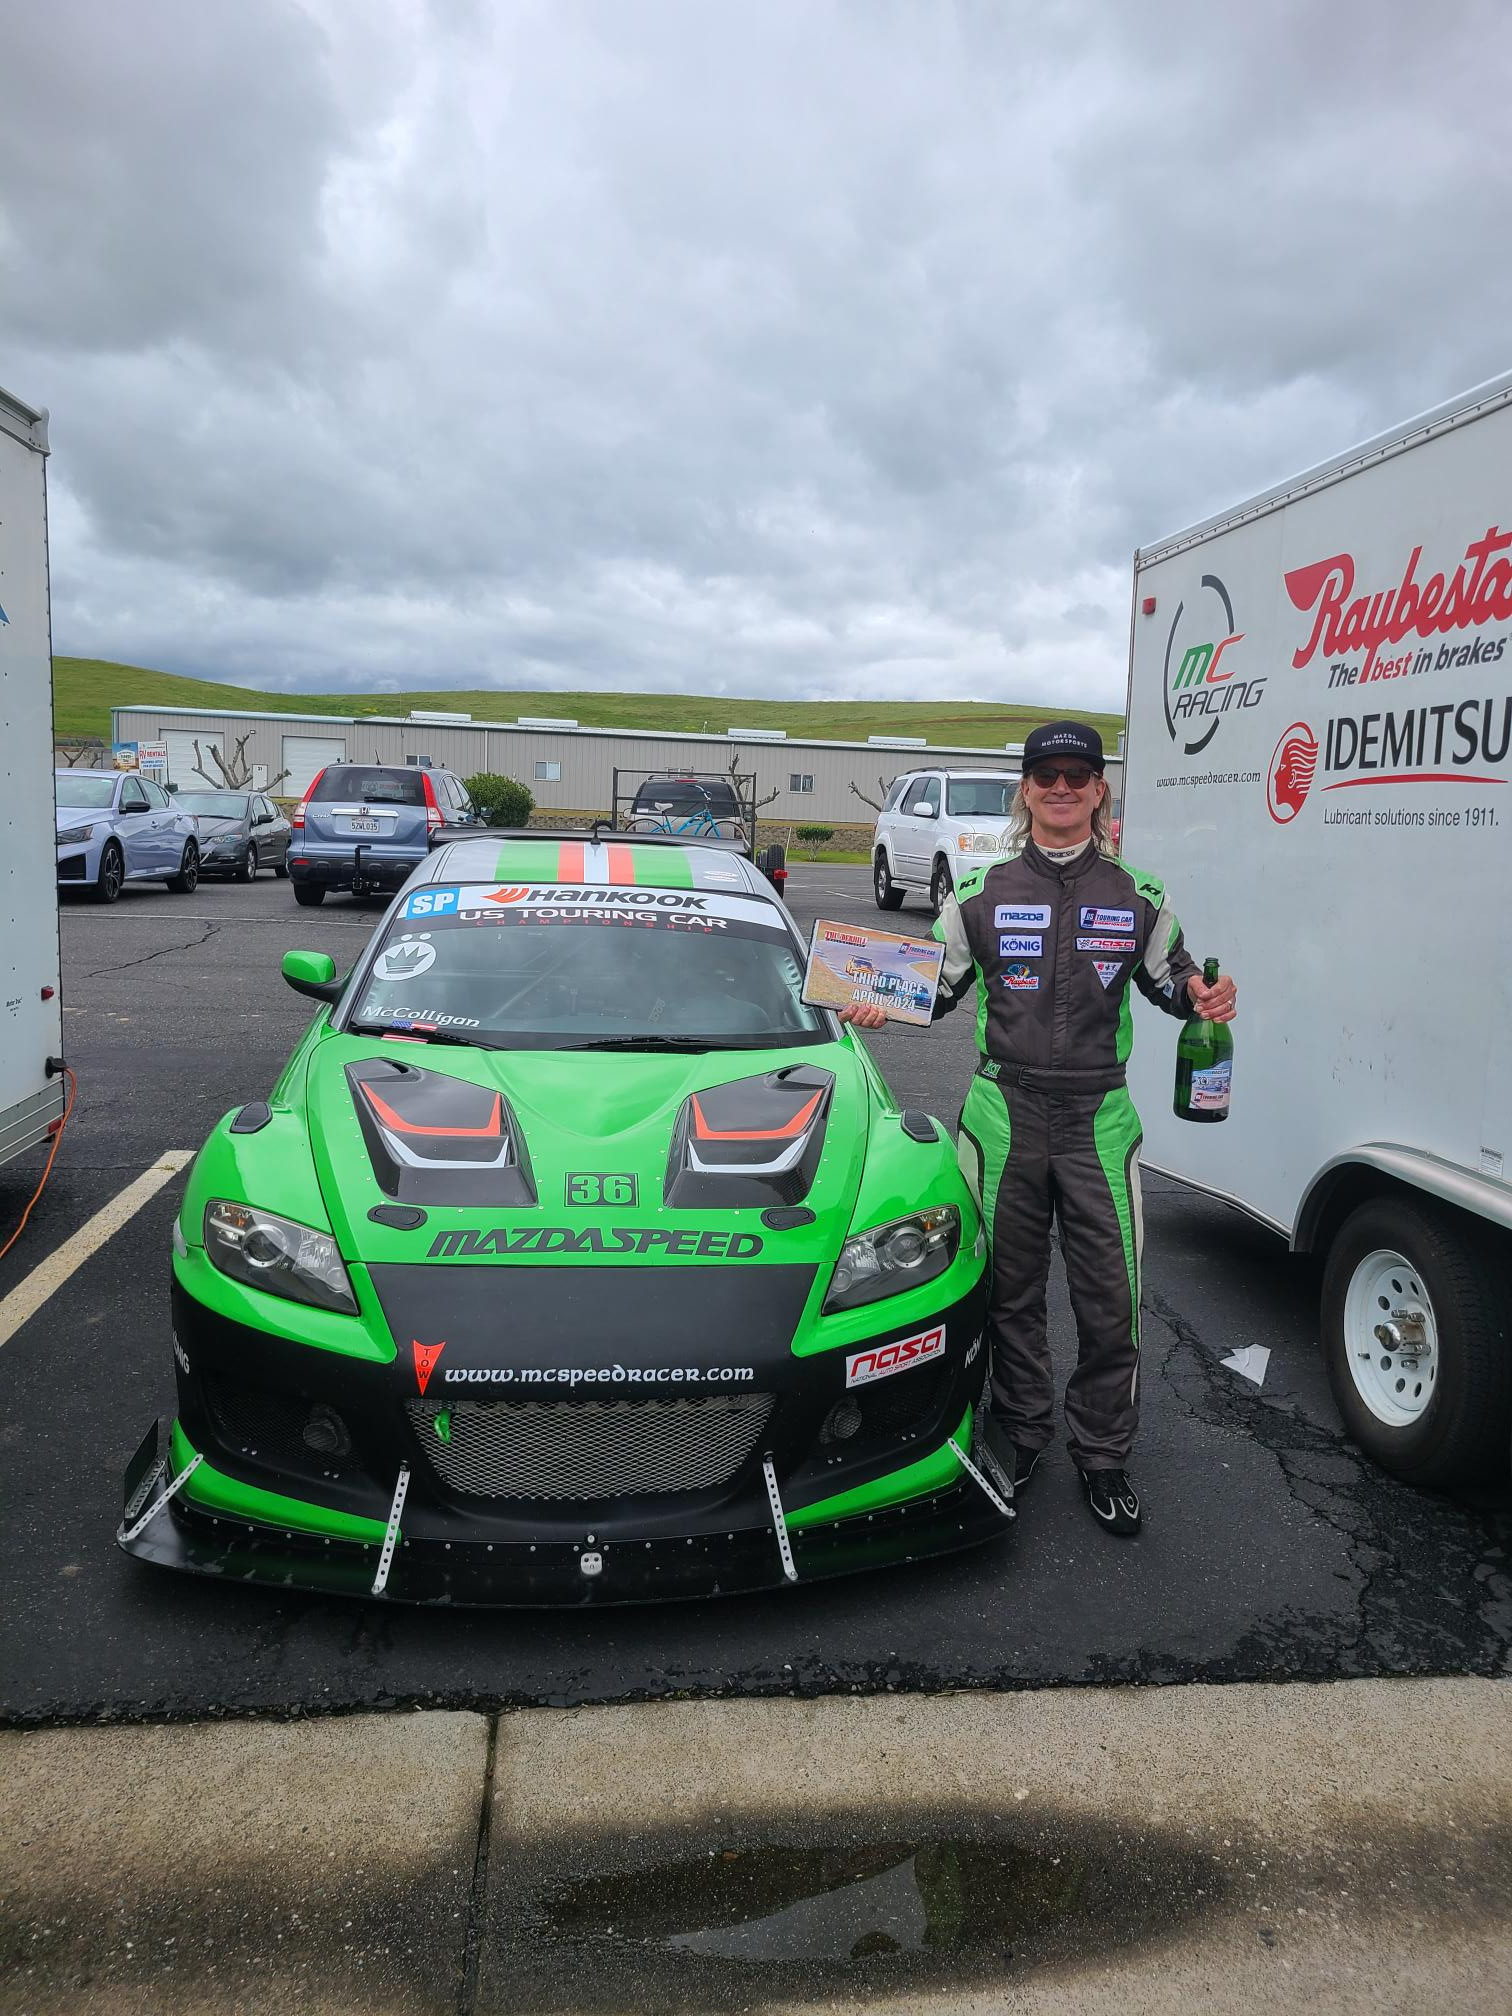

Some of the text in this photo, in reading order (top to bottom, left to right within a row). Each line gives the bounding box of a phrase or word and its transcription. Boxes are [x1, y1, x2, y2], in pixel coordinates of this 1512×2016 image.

[1327, 636, 1508, 688] The best in brakes
[1172, 677, 1268, 720] RACING
[1041, 738, 1088, 749] MOTORSPORTS
[1324, 696, 1512, 771] IDEMITSU
[1156, 771, 1261, 788] www.mcspeedracer.com
[1324, 807, 1499, 826] Lubricant solutions since 1911.
[411, 892, 455, 914] SP
[459, 908, 728, 929] US TOURING CAR
[852, 971, 923, 994] THIRD PLACE
[851, 988, 916, 1011] APRIL 2024
[362, 1006, 481, 1028] McColligan
[570, 1174, 633, 1204] 36
[425, 1227, 765, 1258] MAZDASPEED
[418, 1348, 431, 1379] TOW
[444, 1364, 755, 1387] www.mcspeedracer.com
